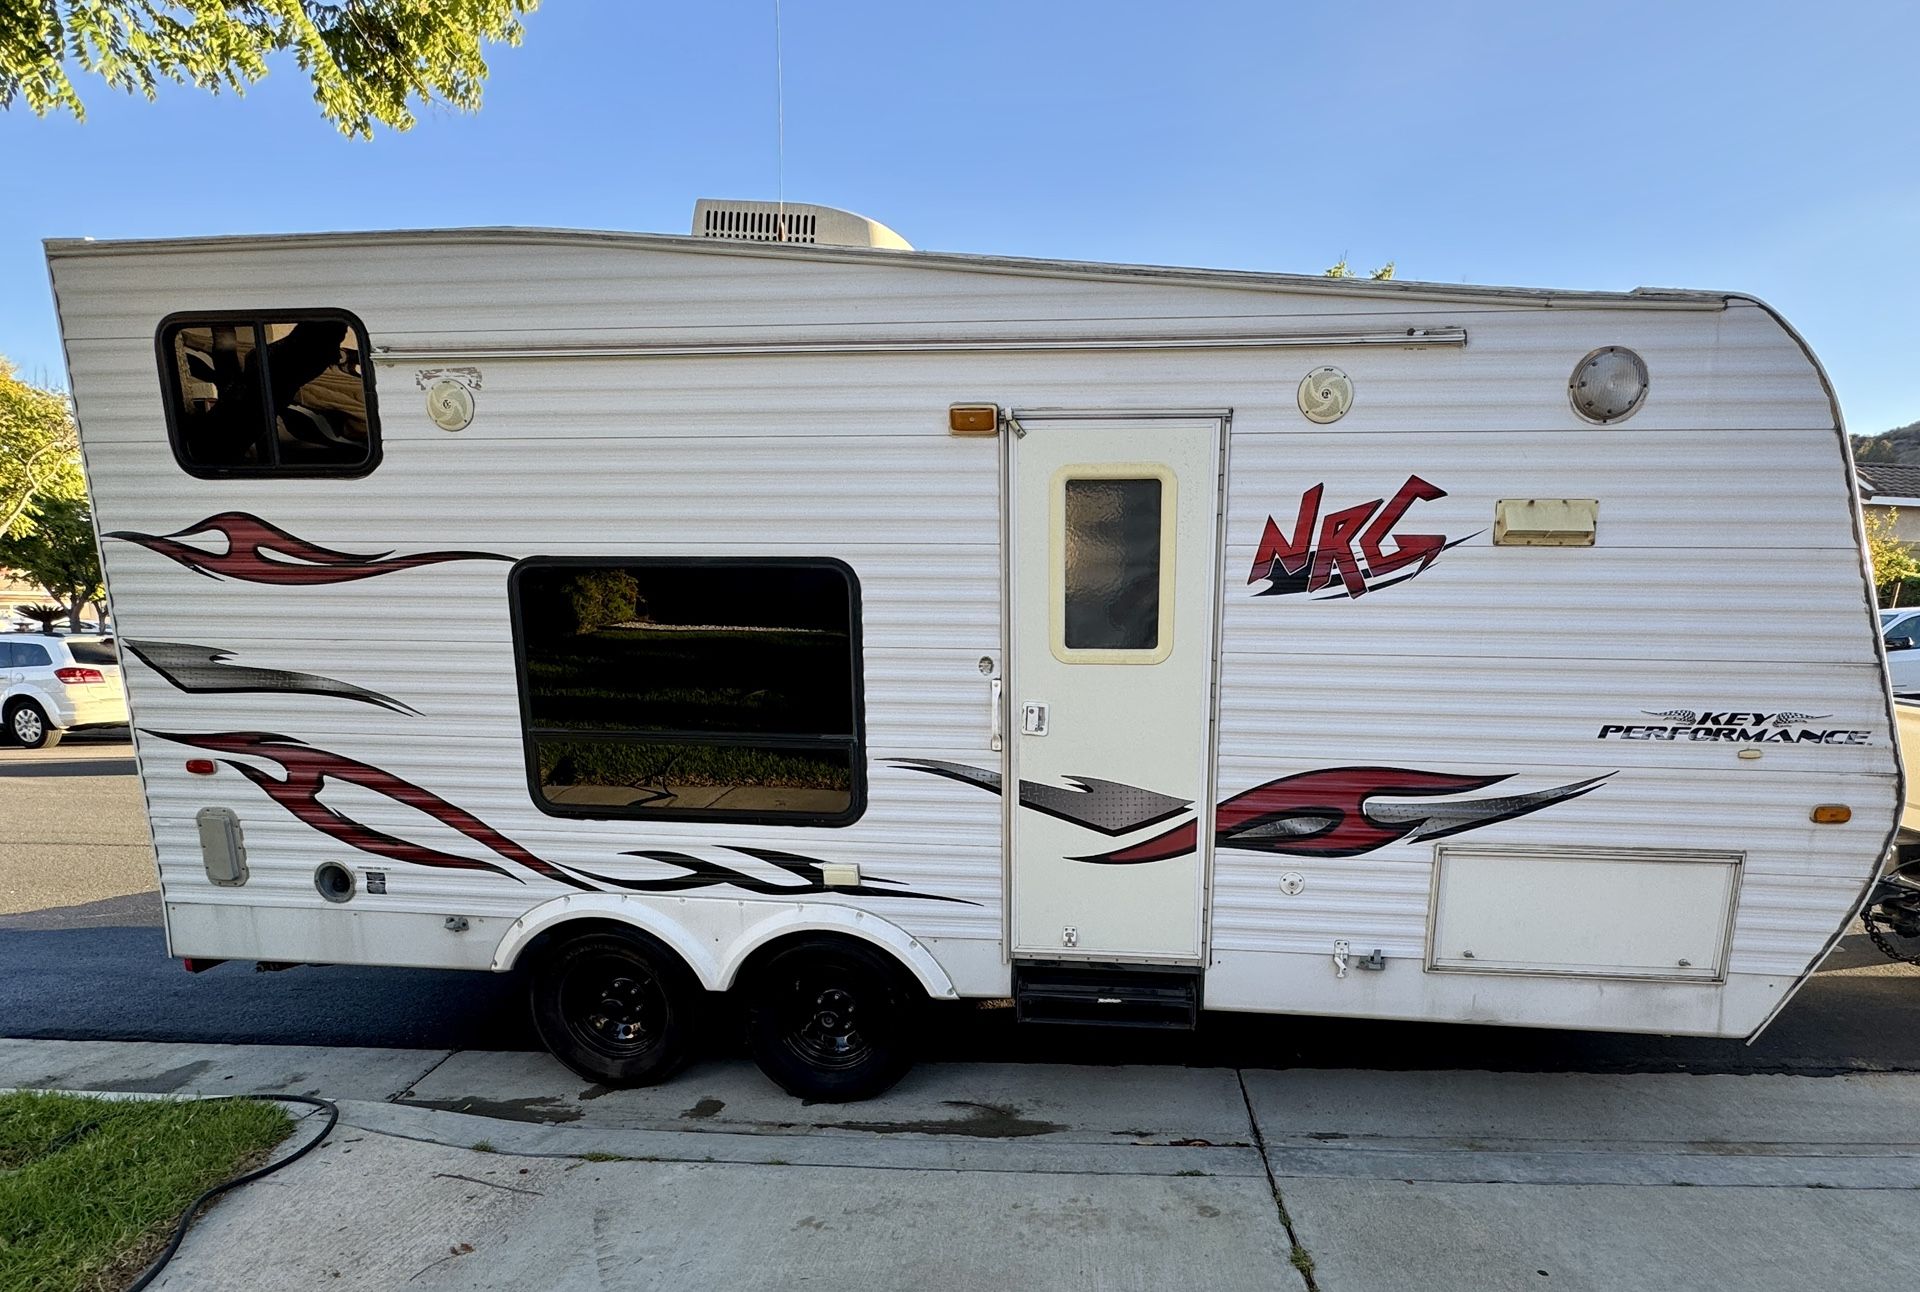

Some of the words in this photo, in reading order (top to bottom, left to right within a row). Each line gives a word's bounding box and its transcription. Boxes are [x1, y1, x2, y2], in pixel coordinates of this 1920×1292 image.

[1247, 474, 1448, 599] NRG
[1696, 711, 1777, 726] KEY
[1597, 725, 1871, 745] PERFORMANCE
